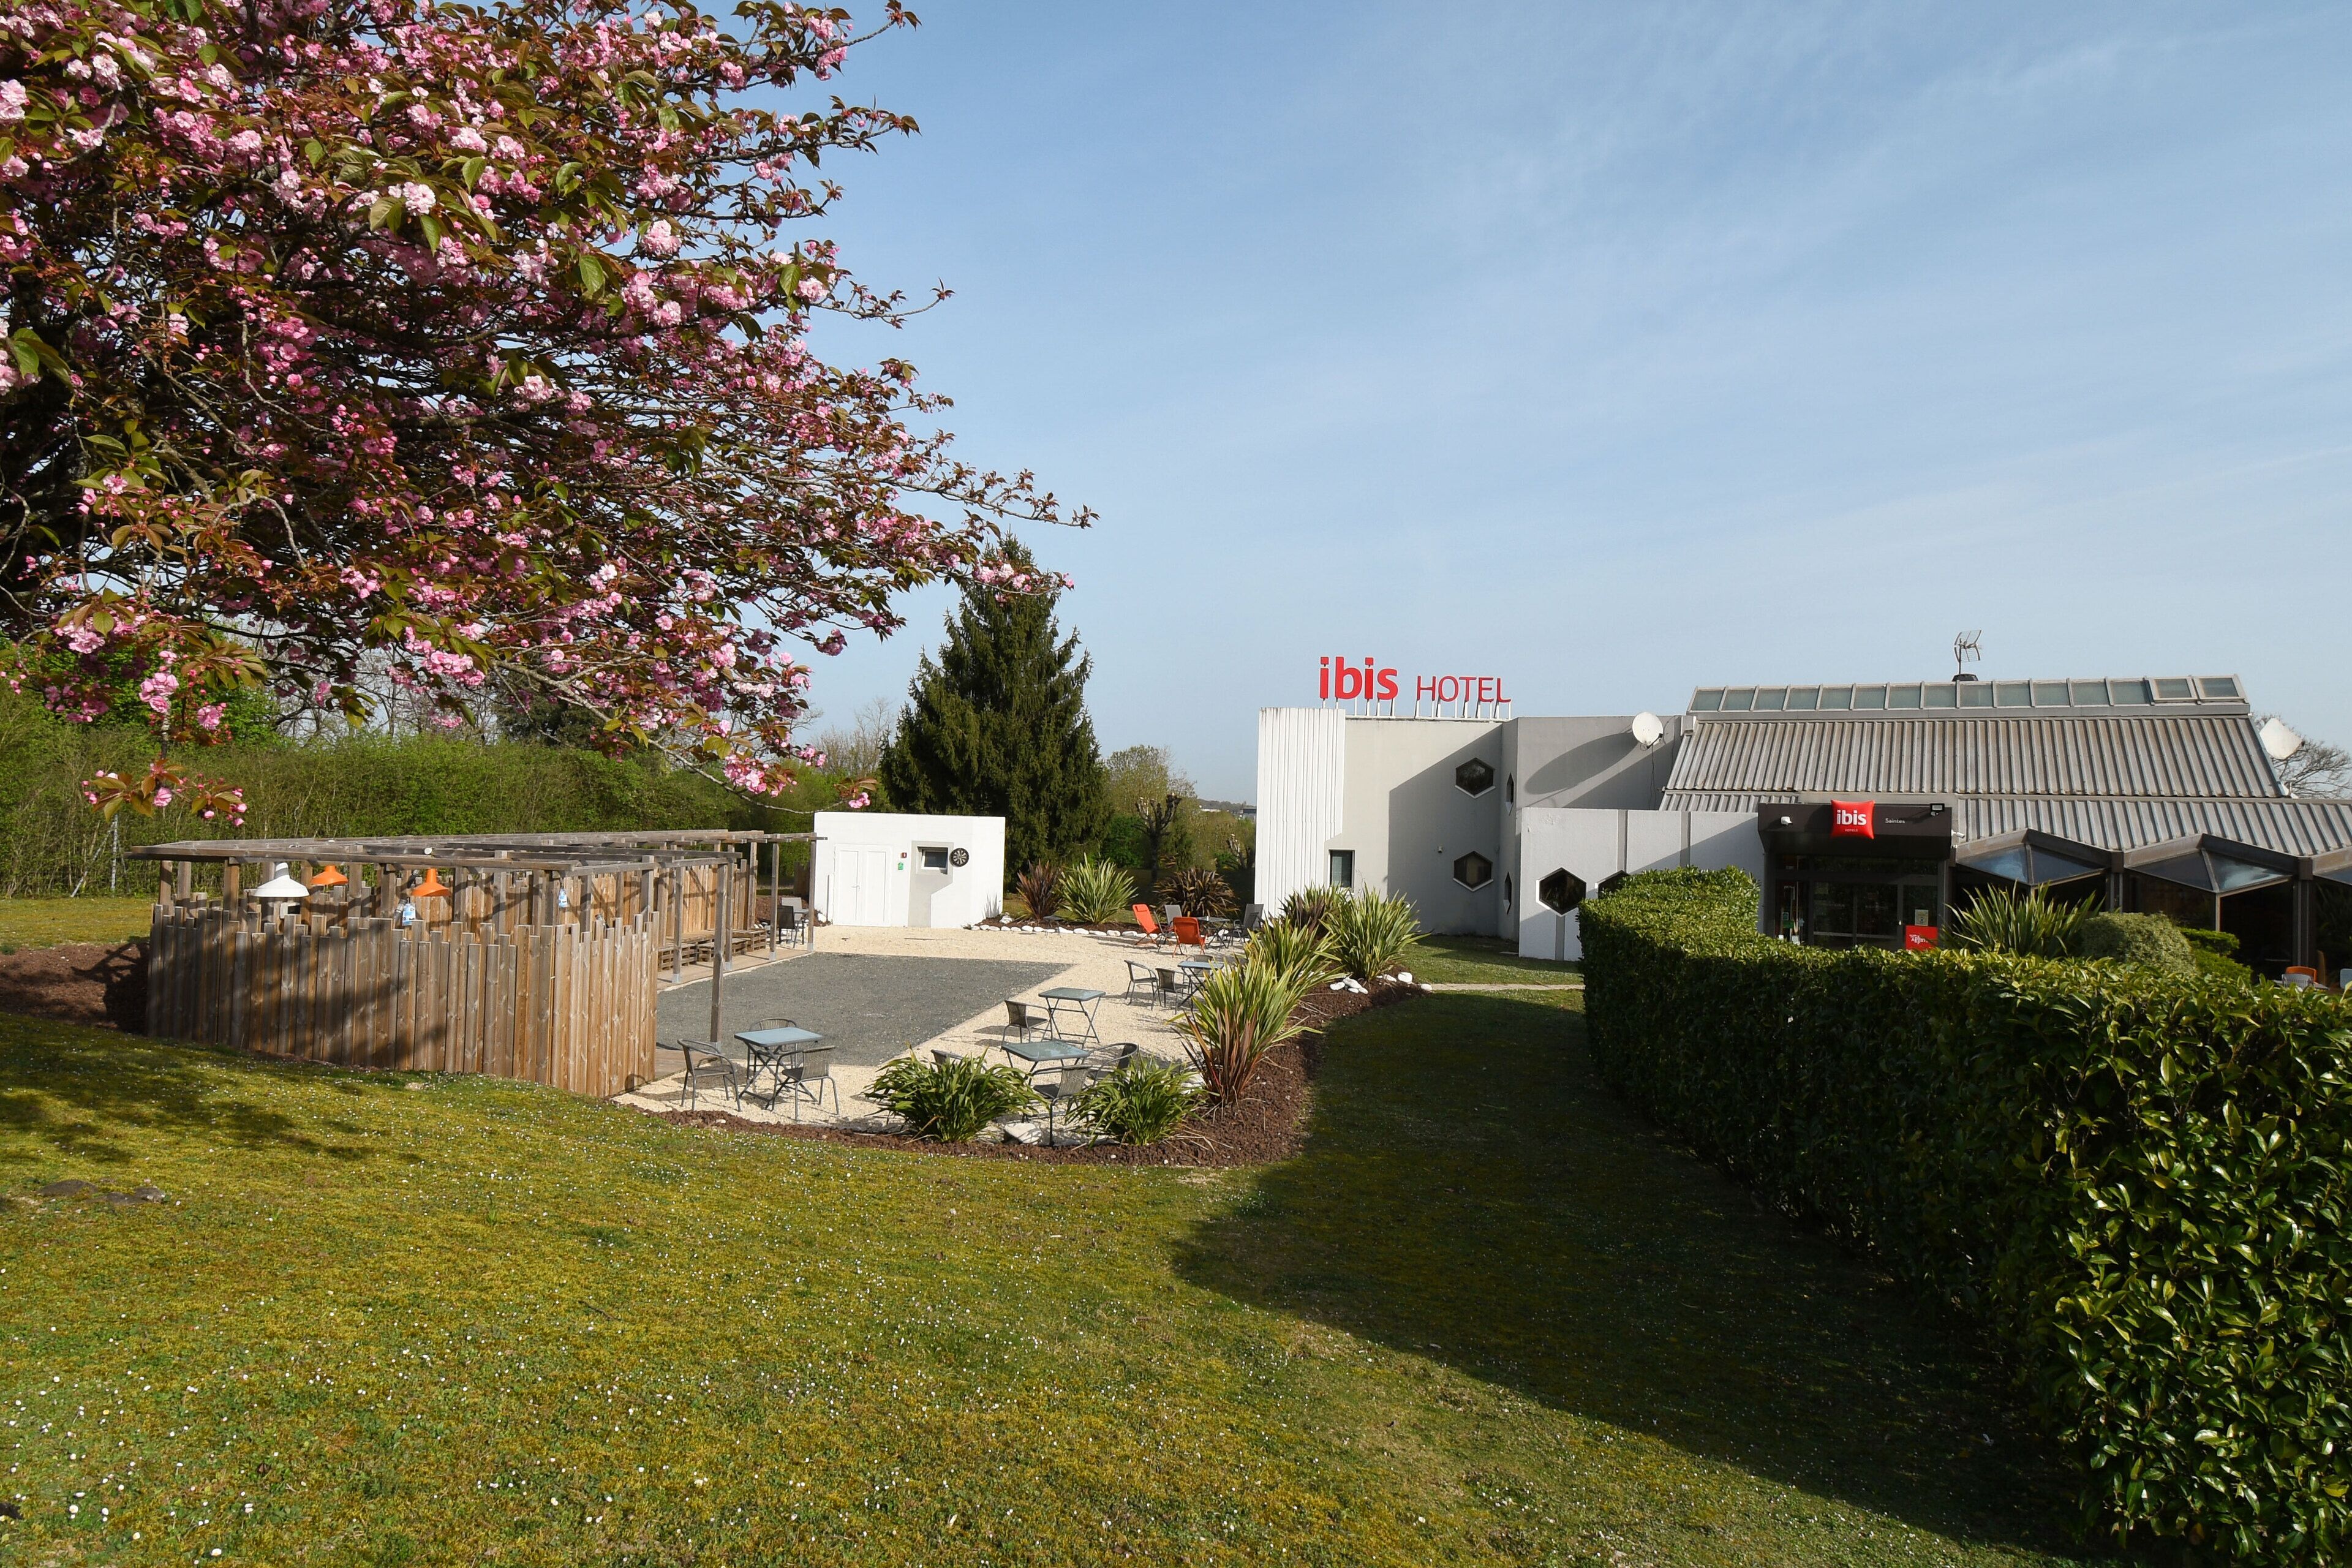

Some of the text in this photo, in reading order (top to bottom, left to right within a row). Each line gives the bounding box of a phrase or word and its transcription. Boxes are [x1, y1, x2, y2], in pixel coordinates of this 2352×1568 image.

[1319, 655, 1512, 703] ibis HOTEL
[1836, 809, 1867, 826] ibis
